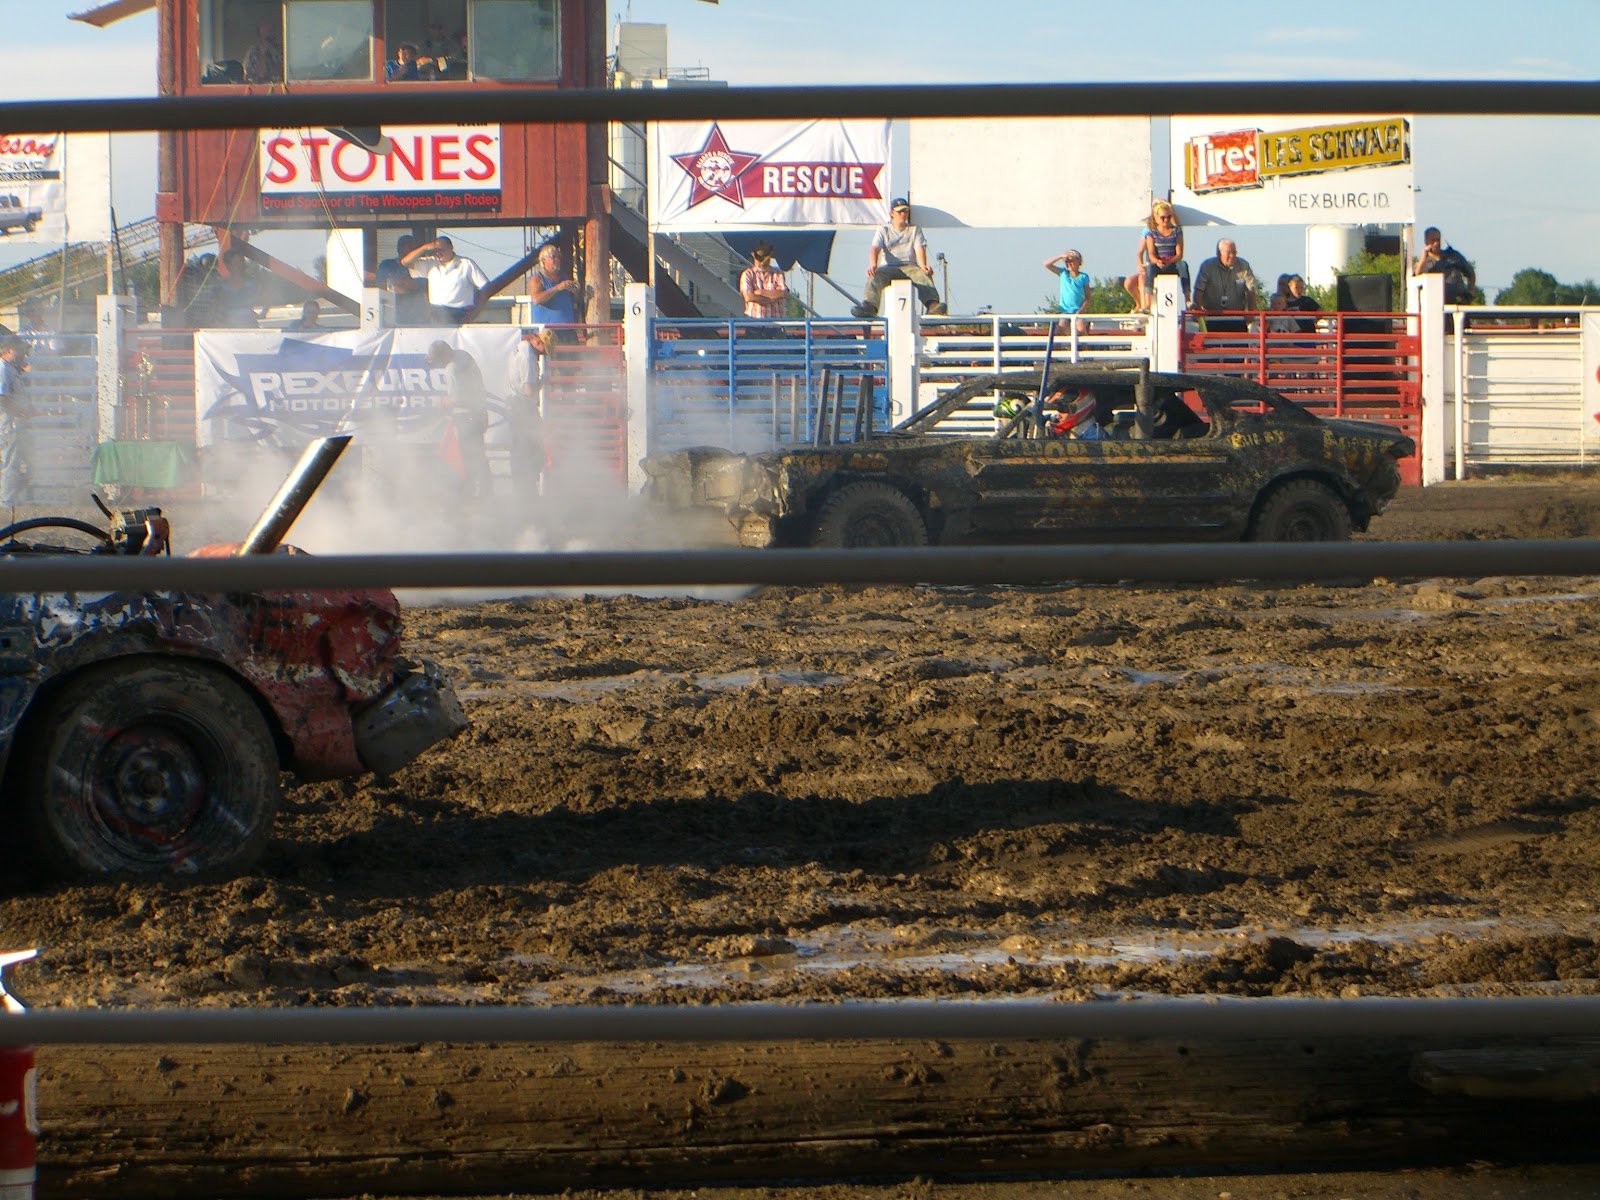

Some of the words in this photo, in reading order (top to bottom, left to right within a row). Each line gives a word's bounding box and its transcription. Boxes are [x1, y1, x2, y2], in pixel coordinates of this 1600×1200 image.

[1263, 135, 1303, 170] LES
[1309, 124, 1399, 163] SCHWAB
[265, 134, 496, 184] STONES
[1193, 136, 1257, 185] Tires
[763, 165, 863, 195] RESCUE
[262, 195, 295, 209] Proud
[344, 194, 356, 208] of
[359, 194, 379, 207] The
[381, 193, 432, 209] Whoopee
[434, 193, 462, 209] Days
[464, 192, 499, 205] Rodeo
[898, 297, 907, 311] 7
[1165, 292, 1174, 307] 8
[366, 307, 375, 321] 5
[632, 301, 642, 316] 6
[102, 311, 112, 325] 4
